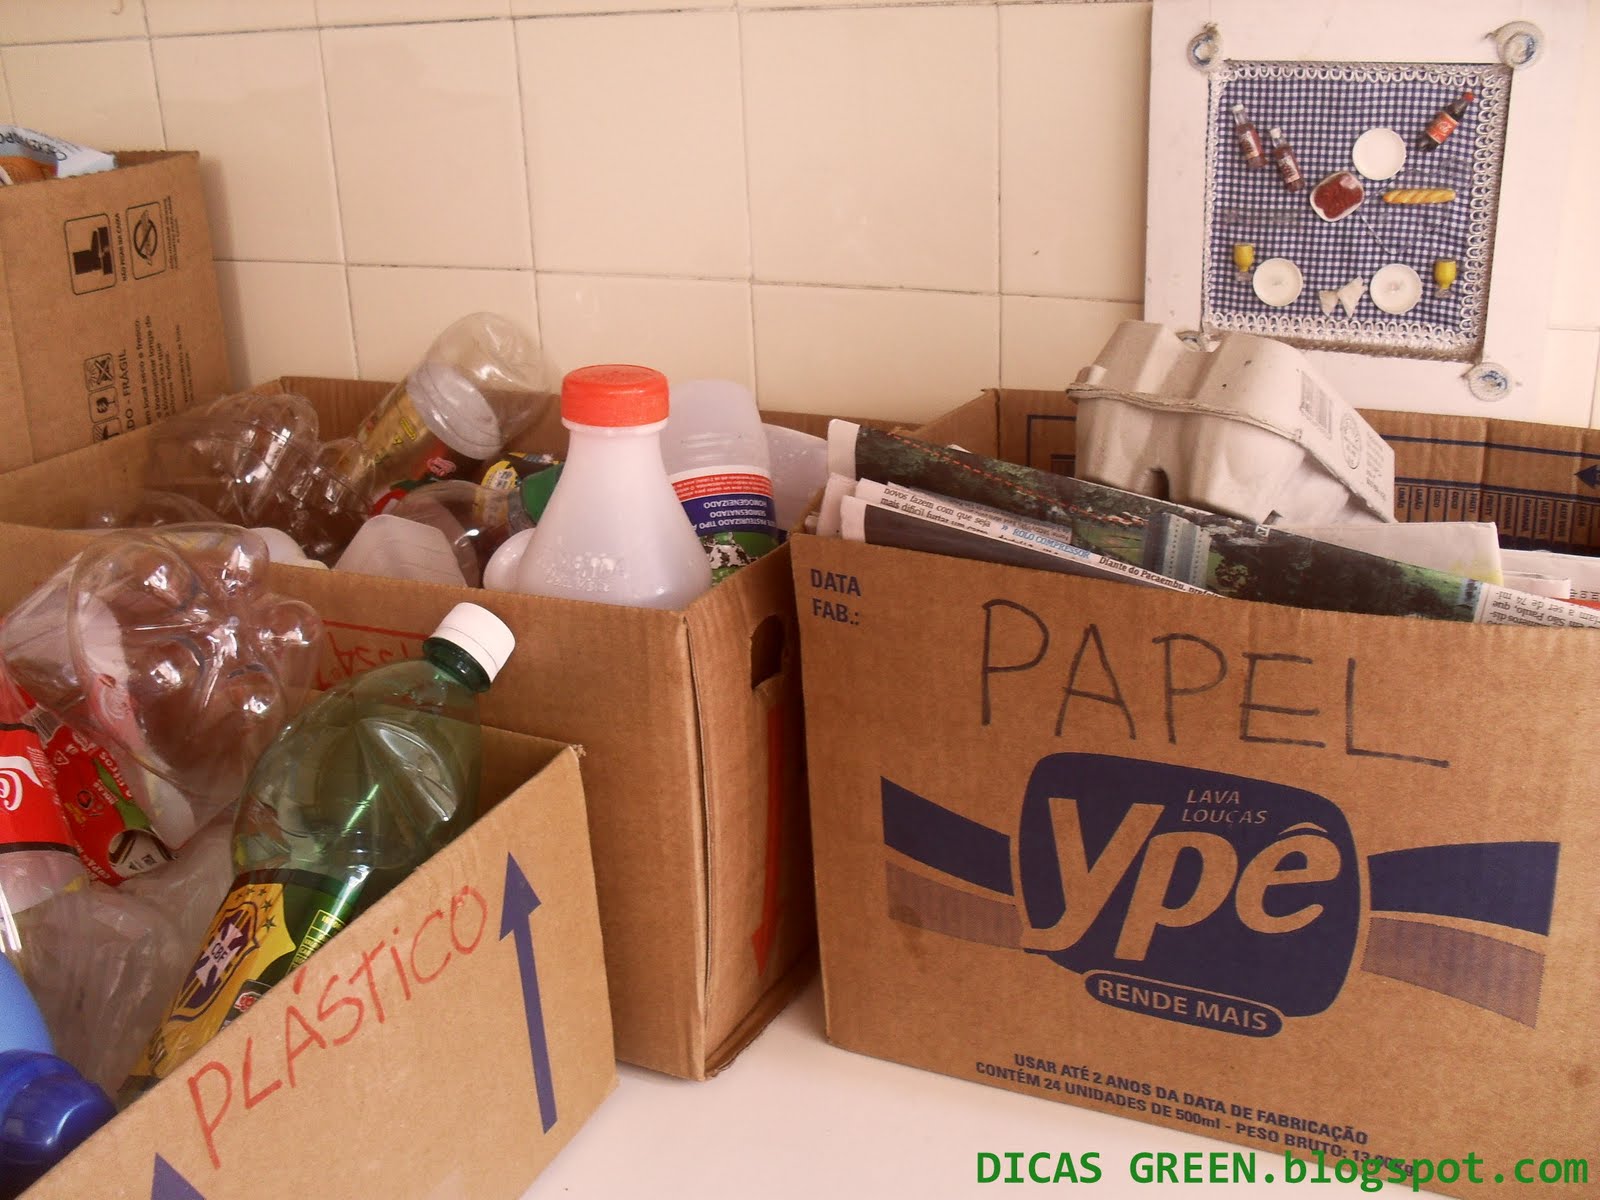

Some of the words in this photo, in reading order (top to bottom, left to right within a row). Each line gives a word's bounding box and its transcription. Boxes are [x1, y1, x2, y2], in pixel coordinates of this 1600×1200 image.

[117, 348, 130, 396] FRÁGIL
[703, 499, 767, 509] HOMOGENEIZADO
[880, 497, 900, 509] mais
[910, 495, 934, 509] fazem
[936, 505, 954, 515] com
[957, 511, 972, 522] que
[974, 517, 991, 528] seja
[710, 509, 766, 518] SEMIDESNATADO
[718, 517, 767, 527] PASTEURIZADO
[699, 520, 717, 530] TIPO
[1012, 528, 1035, 541] ROLO
[1036, 536, 1091, 559] COMPRESSOR
[1098, 556, 1128, 572] Diante
[1128, 566, 1140, 576] do
[811, 568, 862, 597] DATA
[1492, 600, 1510, 611] que
[1516, 596, 1527, 606] 74
[1531, 600, 1545, 610] de
[1548, 603, 1564, 613] ser
[811, 597, 860, 626] FAB.:
[1514, 605, 1544, 621] Paulo,
[981, 598, 1450, 769] PAPEL
[1186, 789, 1240, 804] LAVA
[1182, 809, 1268, 826] LOUÇAS
[211, 943, 228, 962] CBF
[1098, 979, 1188, 1015] RENDE
[1196, 1001, 1268, 1031] MAIS
[1014, 1053, 1057, 1074] USAR
[1061, 1065, 1090, 1081] ATÉ
[1093, 1072, 1103, 1084] 2
[1105, 1074, 1152, 1096] ANOS
[1156, 1086, 1180, 1103] DA
[1183, 1092, 1226, 1114] DATA
[1231, 1103, 1253, 1120] DE
[1257, 1110, 1369, 1145] FABRICAÇÃO
[975, 1062, 1041, 1087] CONTÉM
[1044, 1078, 1061, 1091] 24
[1065, 1082, 1147, 1111] UNIDADES
[1151, 1102, 1172, 1117] DE
[1176, 1106, 1220, 1129] 500ml
[1235, 1122, 1280, 1143] PESO
[1284, 1133, 1347, 1158] BRUTO:
